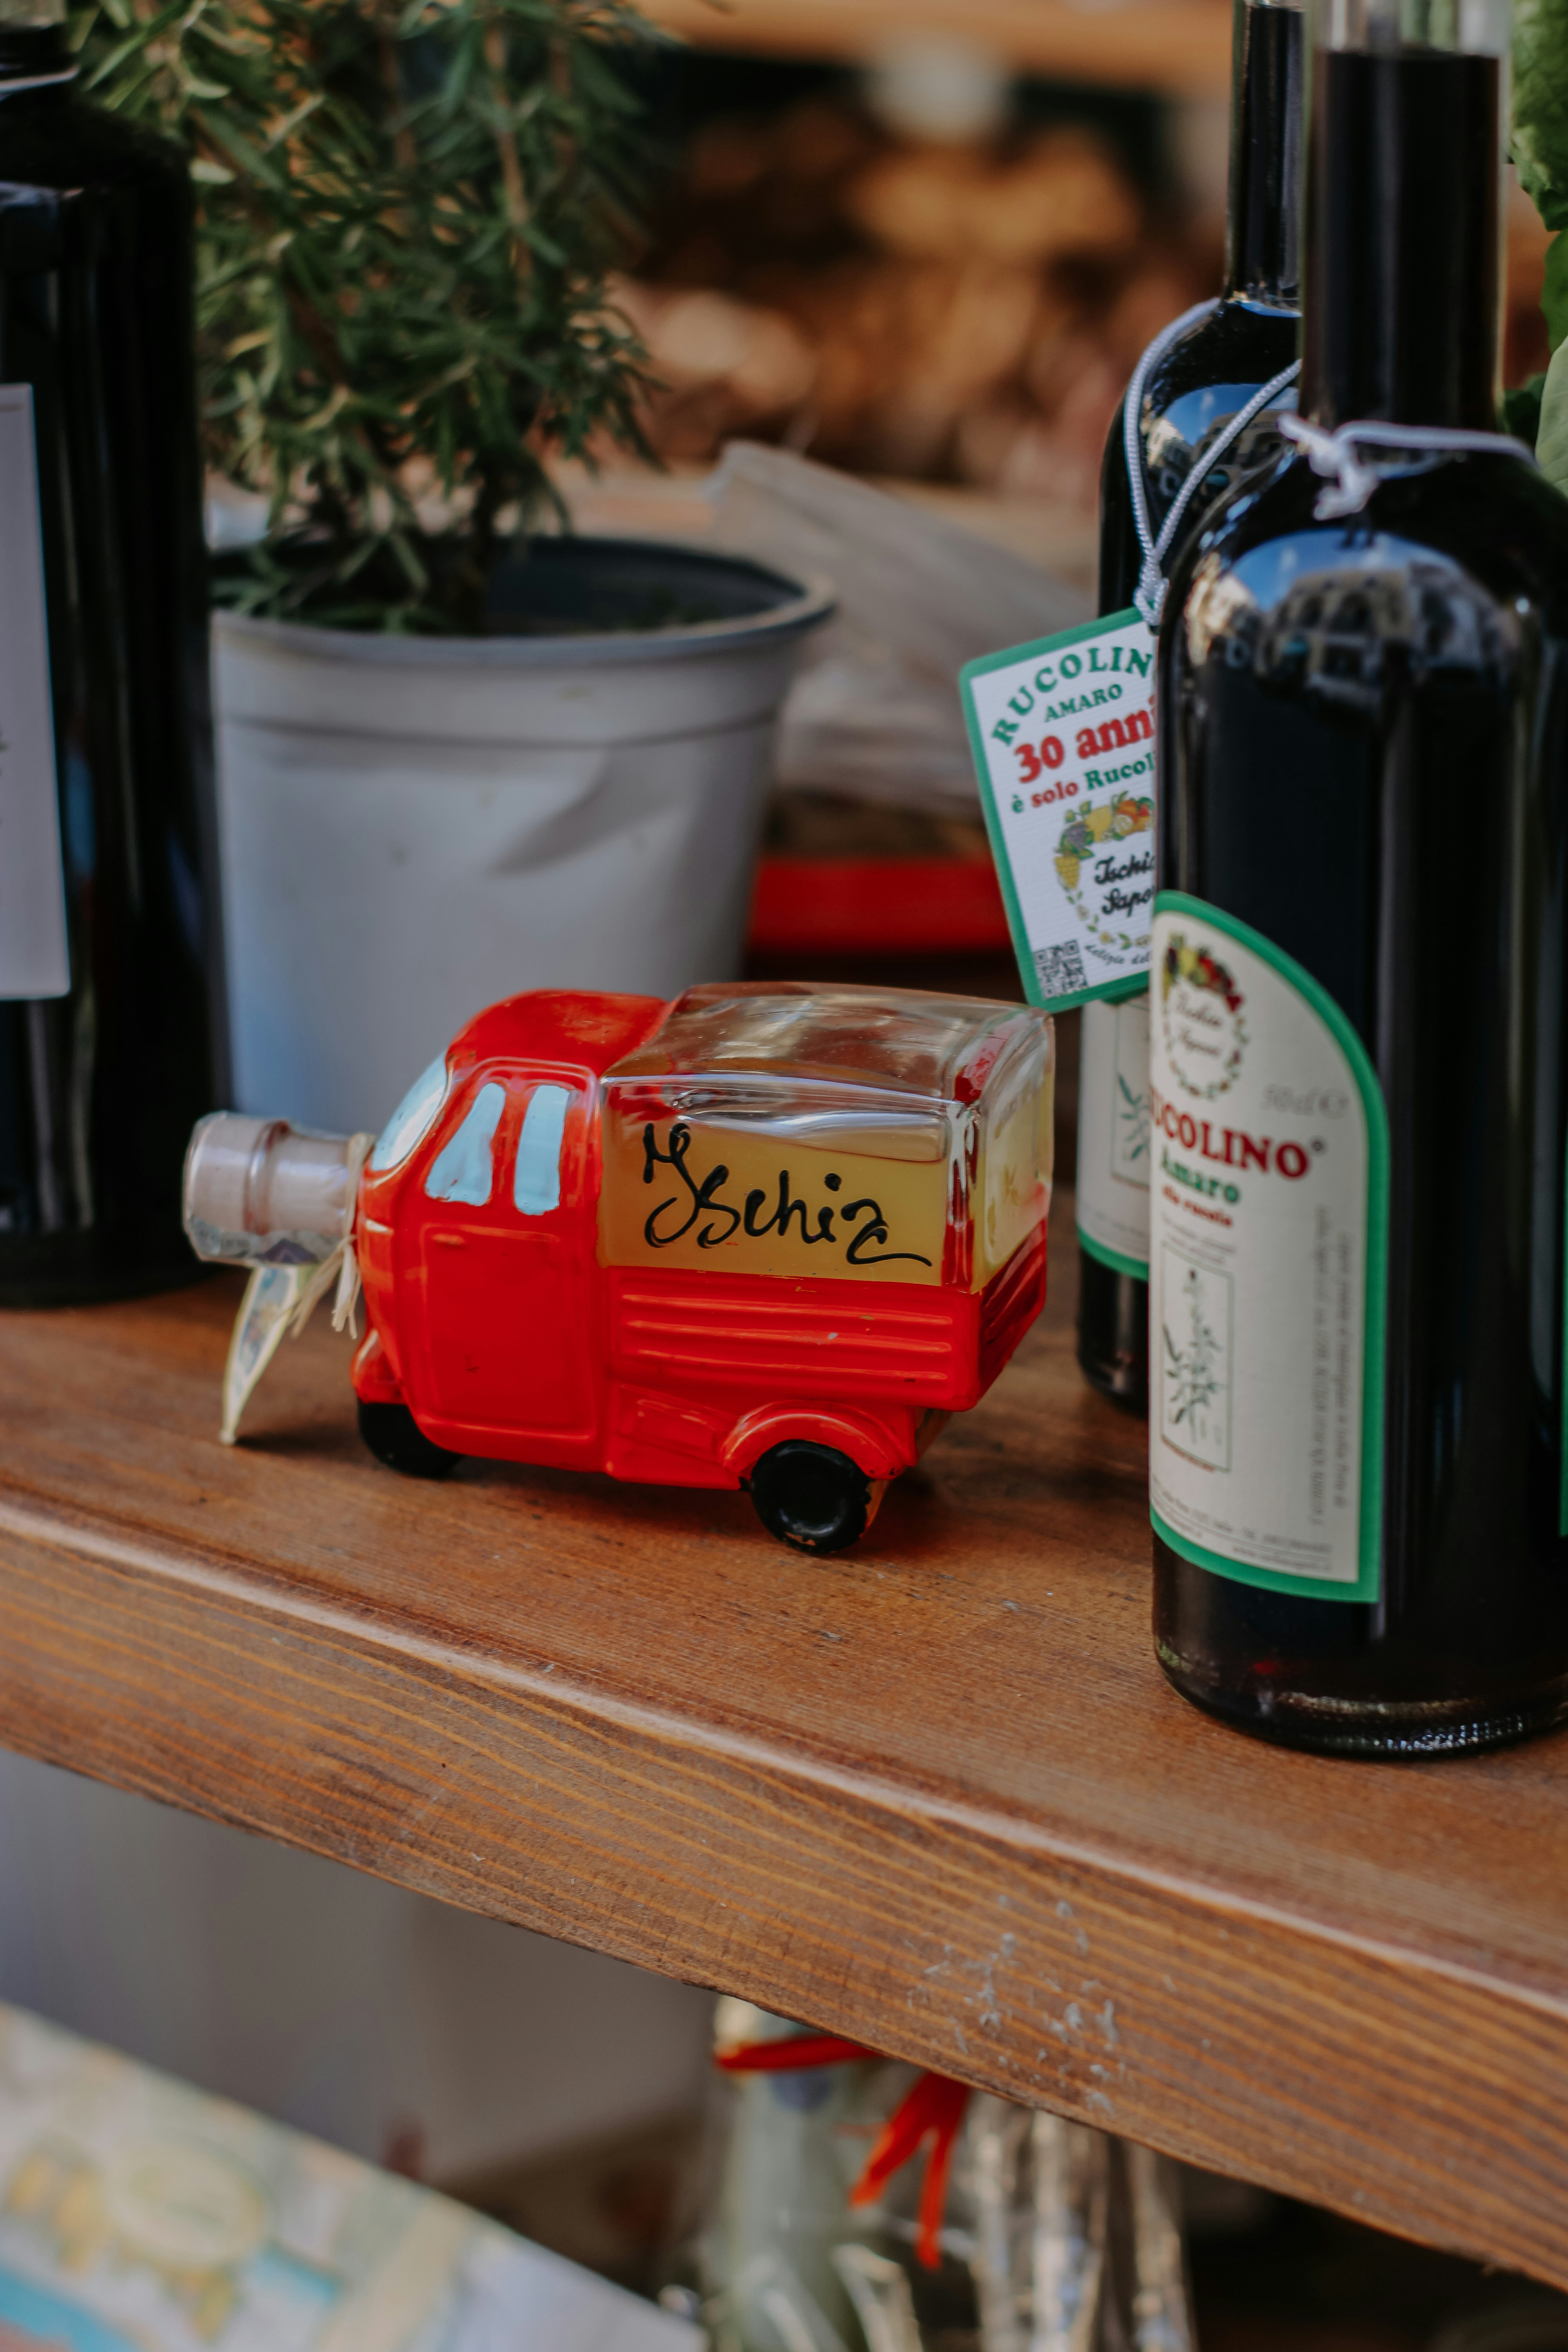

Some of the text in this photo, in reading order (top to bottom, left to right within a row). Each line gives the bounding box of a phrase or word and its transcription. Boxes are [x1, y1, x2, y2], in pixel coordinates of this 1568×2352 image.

[992, 647, 1156, 746] RUCOLIN
[1045, 683, 1123, 722] AMARO
[1014, 735, 1065, 784] 30
[1012, 793, 1024, 813] è
[1031, 781, 1079, 808] solo
[1102, 887, 1155, 918] Sapo
[1160, 1145, 1240, 1205] Amaro
